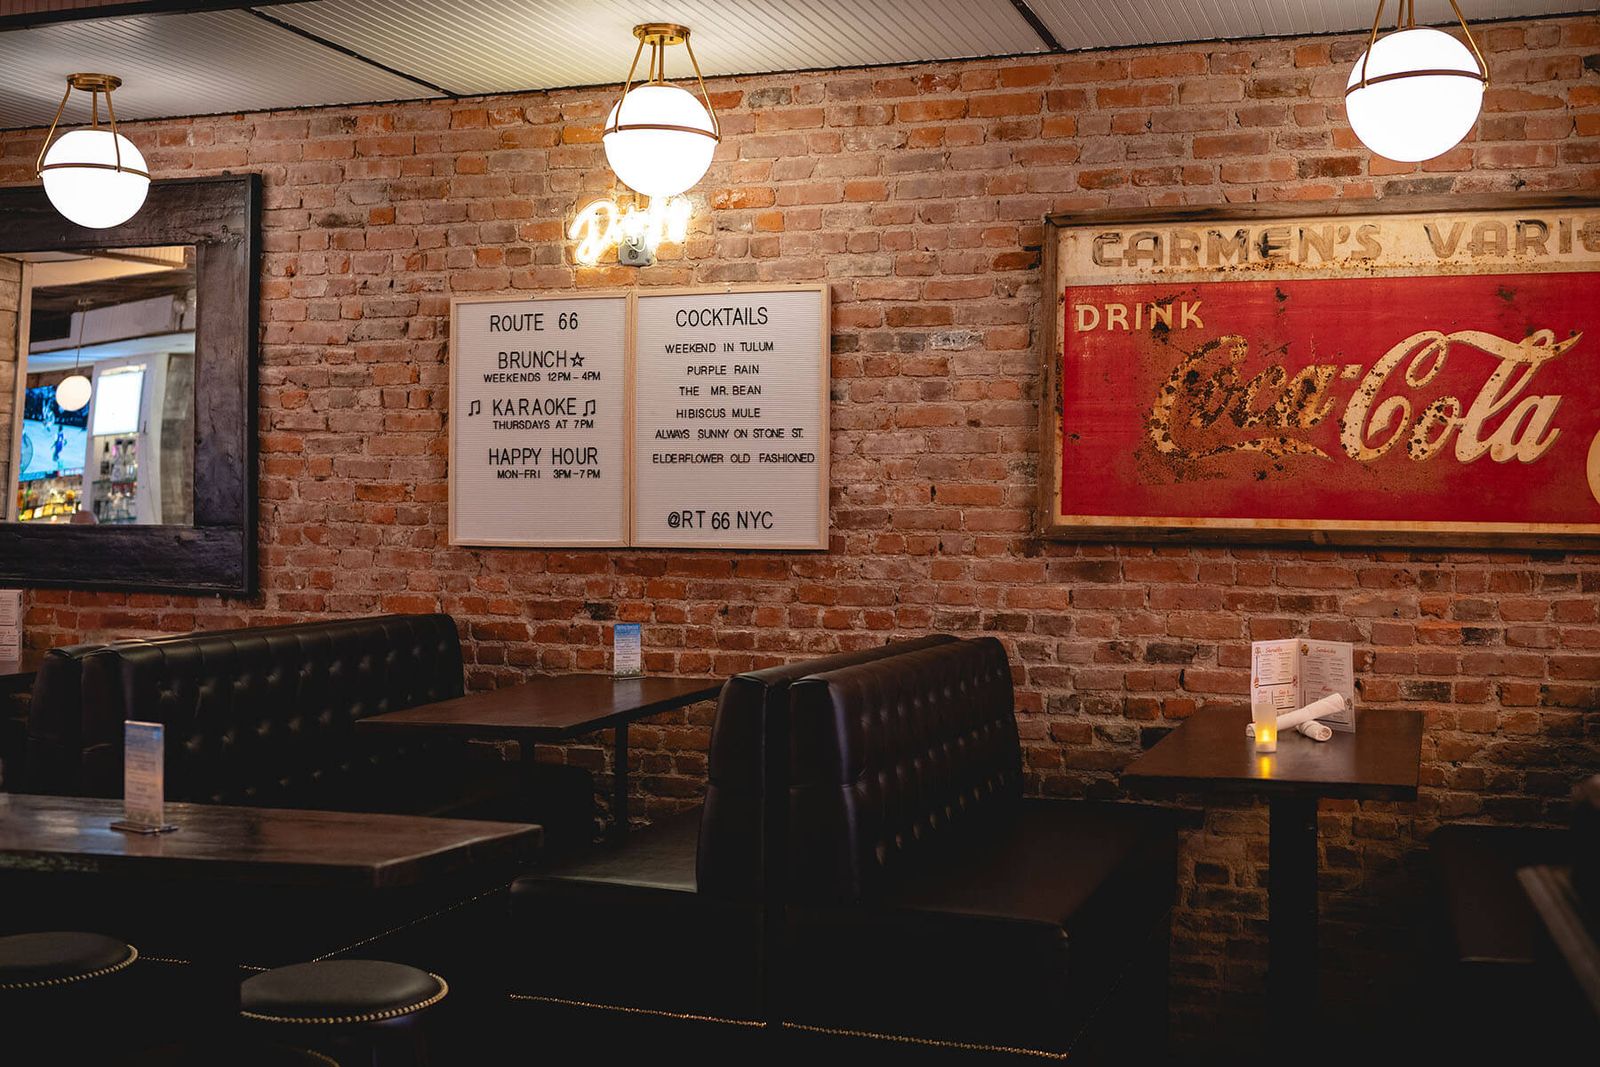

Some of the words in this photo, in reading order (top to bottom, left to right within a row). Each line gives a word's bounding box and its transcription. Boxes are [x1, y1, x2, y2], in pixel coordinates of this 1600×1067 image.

[1092, 223, 1383, 267] CARMEN'S
[490, 313, 544, 332] ROUTE
[559, 312, 578, 330] 66
[676, 307, 768, 328] COCKTAILS
[1075, 301, 1204, 332] DRINK
[665, 343, 716, 353] WEEKEND
[724, 343, 734, 352] IN
[740, 341, 774, 352] TULUM
[498, 350, 567, 369] BRUNCH
[687, 365, 727, 375] PURPLE
[734, 364, 759, 375] RAIN
[483, 372, 541, 383] WEEKENDS
[679, 386, 699, 396] THE
[711, 386, 728, 395] MR.
[732, 385, 761, 395] BEAN
[1149, 329, 1584, 464] Coca-Cola
[493, 398, 577, 416] KARAOKE
[676, 408, 726, 419] HIBISCUS
[732, 408, 761, 418] MULE
[493, 420, 550, 430] THURSDAYS
[555, 419, 568, 429] AT
[574, 419, 593, 428] 7PM
[655, 429, 690, 439] ALWAYS
[698, 429, 729, 440] SUNNY
[734, 429, 748, 439] ON
[753, 428, 784, 438] STONE
[792, 428, 803, 438] ST.
[489, 448, 542, 465] HAPPY
[552, 447, 598, 465] HOUR
[653, 453, 724, 464] ELDERFLOWER
[730, 453, 750, 463] OLD
[759, 453, 815, 463] FASHIONED
[497, 469, 540, 480] MON-FRI
[711, 512, 730, 531] 66
[737, 511, 773, 530] NYC
